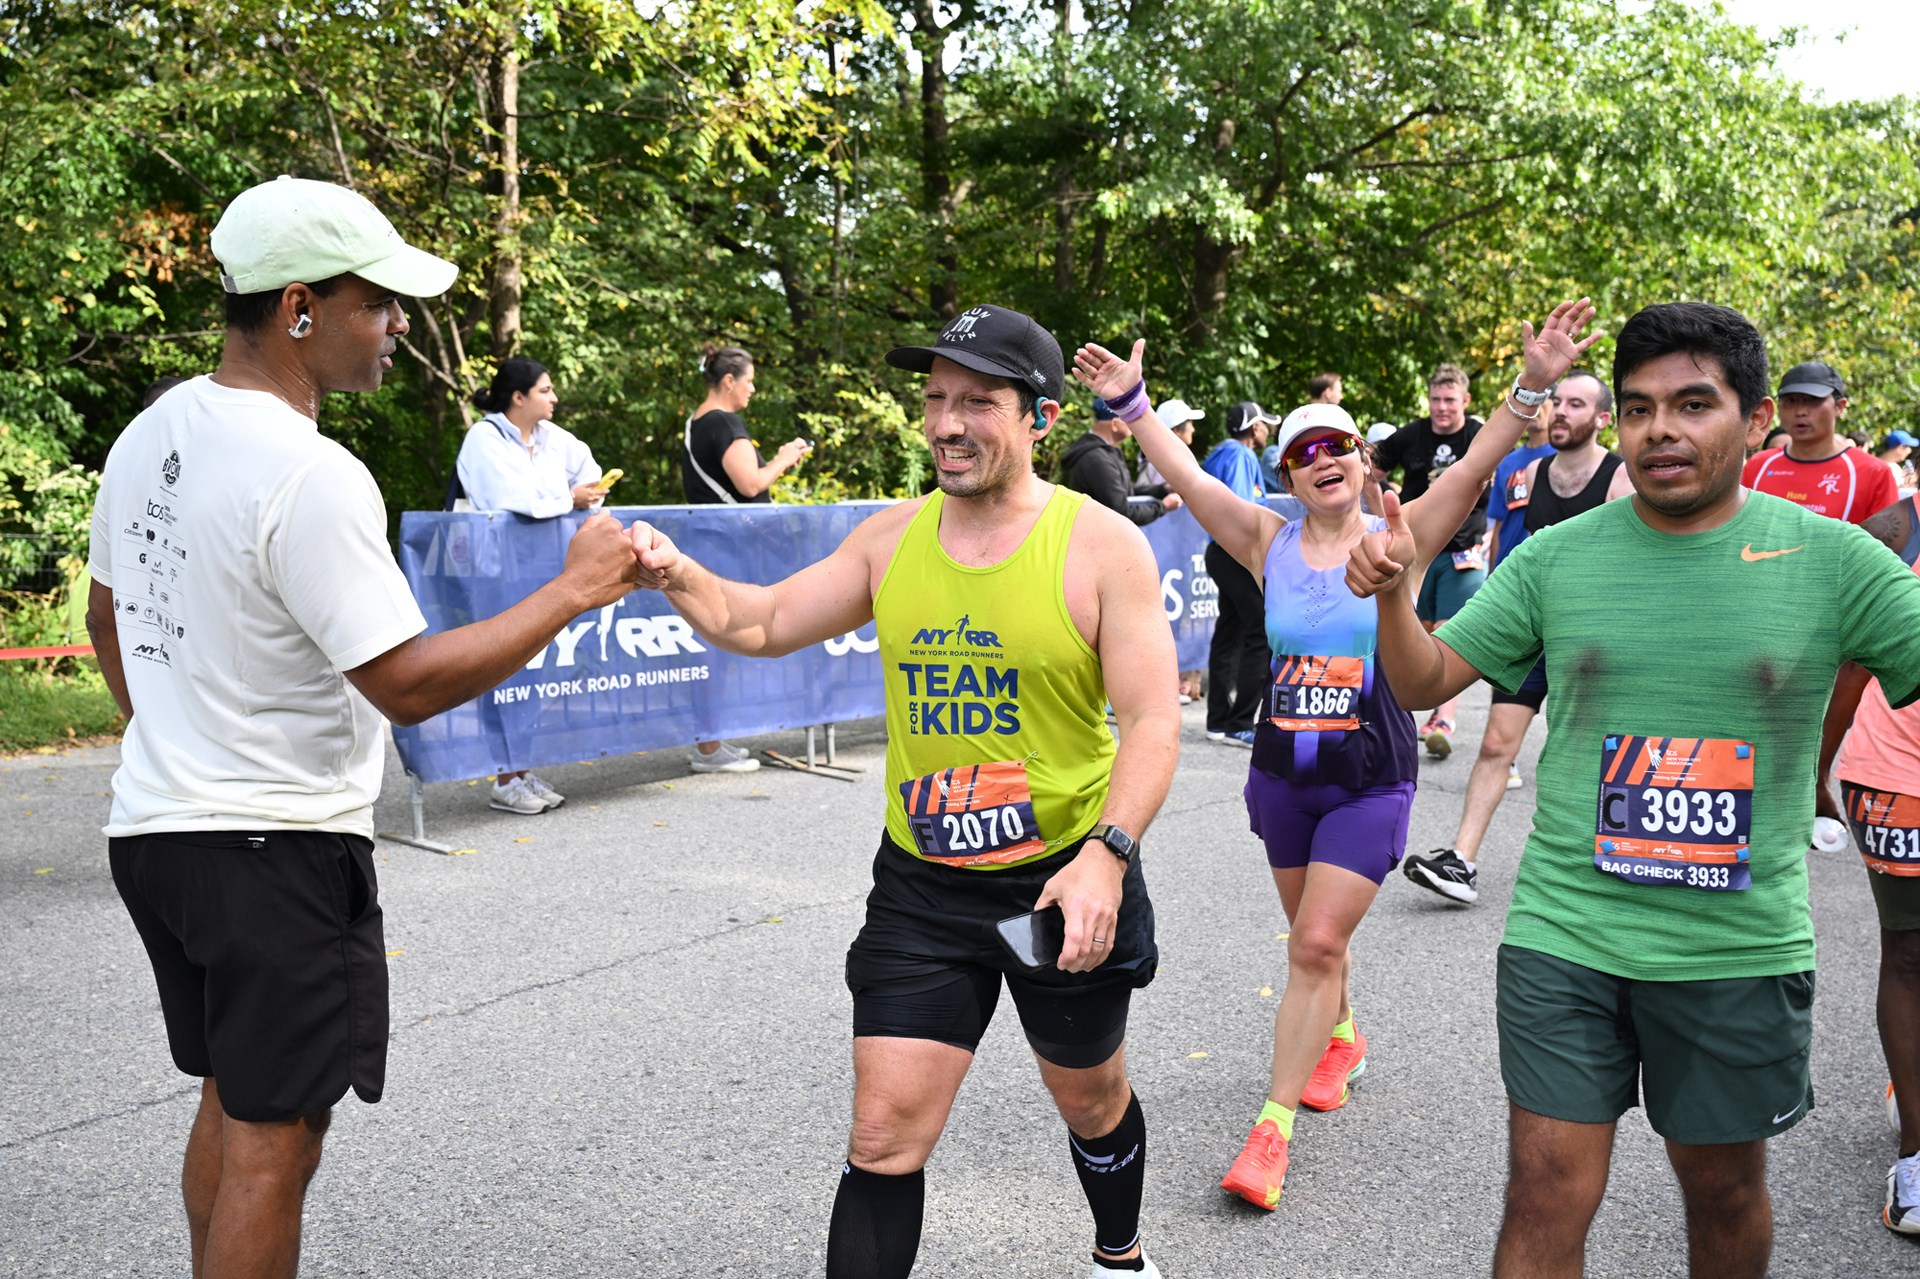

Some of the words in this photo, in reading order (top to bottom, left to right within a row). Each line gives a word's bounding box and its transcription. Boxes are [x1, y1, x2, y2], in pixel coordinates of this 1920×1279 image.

[162, 458, 181, 478] BRONX
[147, 498, 164, 521] tcs
[971, 652, 1004, 660] RUNNERS
[494, 685, 531, 705] NEW
[535, 679, 583, 699] YORK
[587, 674, 631, 692] ROAD
[636, 665, 710, 686] RUNNERS
[898, 662, 1019, 699] TEAM
[1295, 686, 1352, 716] 1866
[909, 701, 919, 735] FOR
[921, 702, 1021, 736] KIDS
[915, 822, 934, 851] F
[942, 806, 1025, 851] 2070
[1603, 792, 1626, 830] C
[1640, 788, 1737, 837] 3933
[1865, 825, 1920, 858] 4731
[1601, 861, 1631, 874] BAG
[1634, 864, 1684, 881] CHECK
[1687, 866, 1729, 888] 3933
